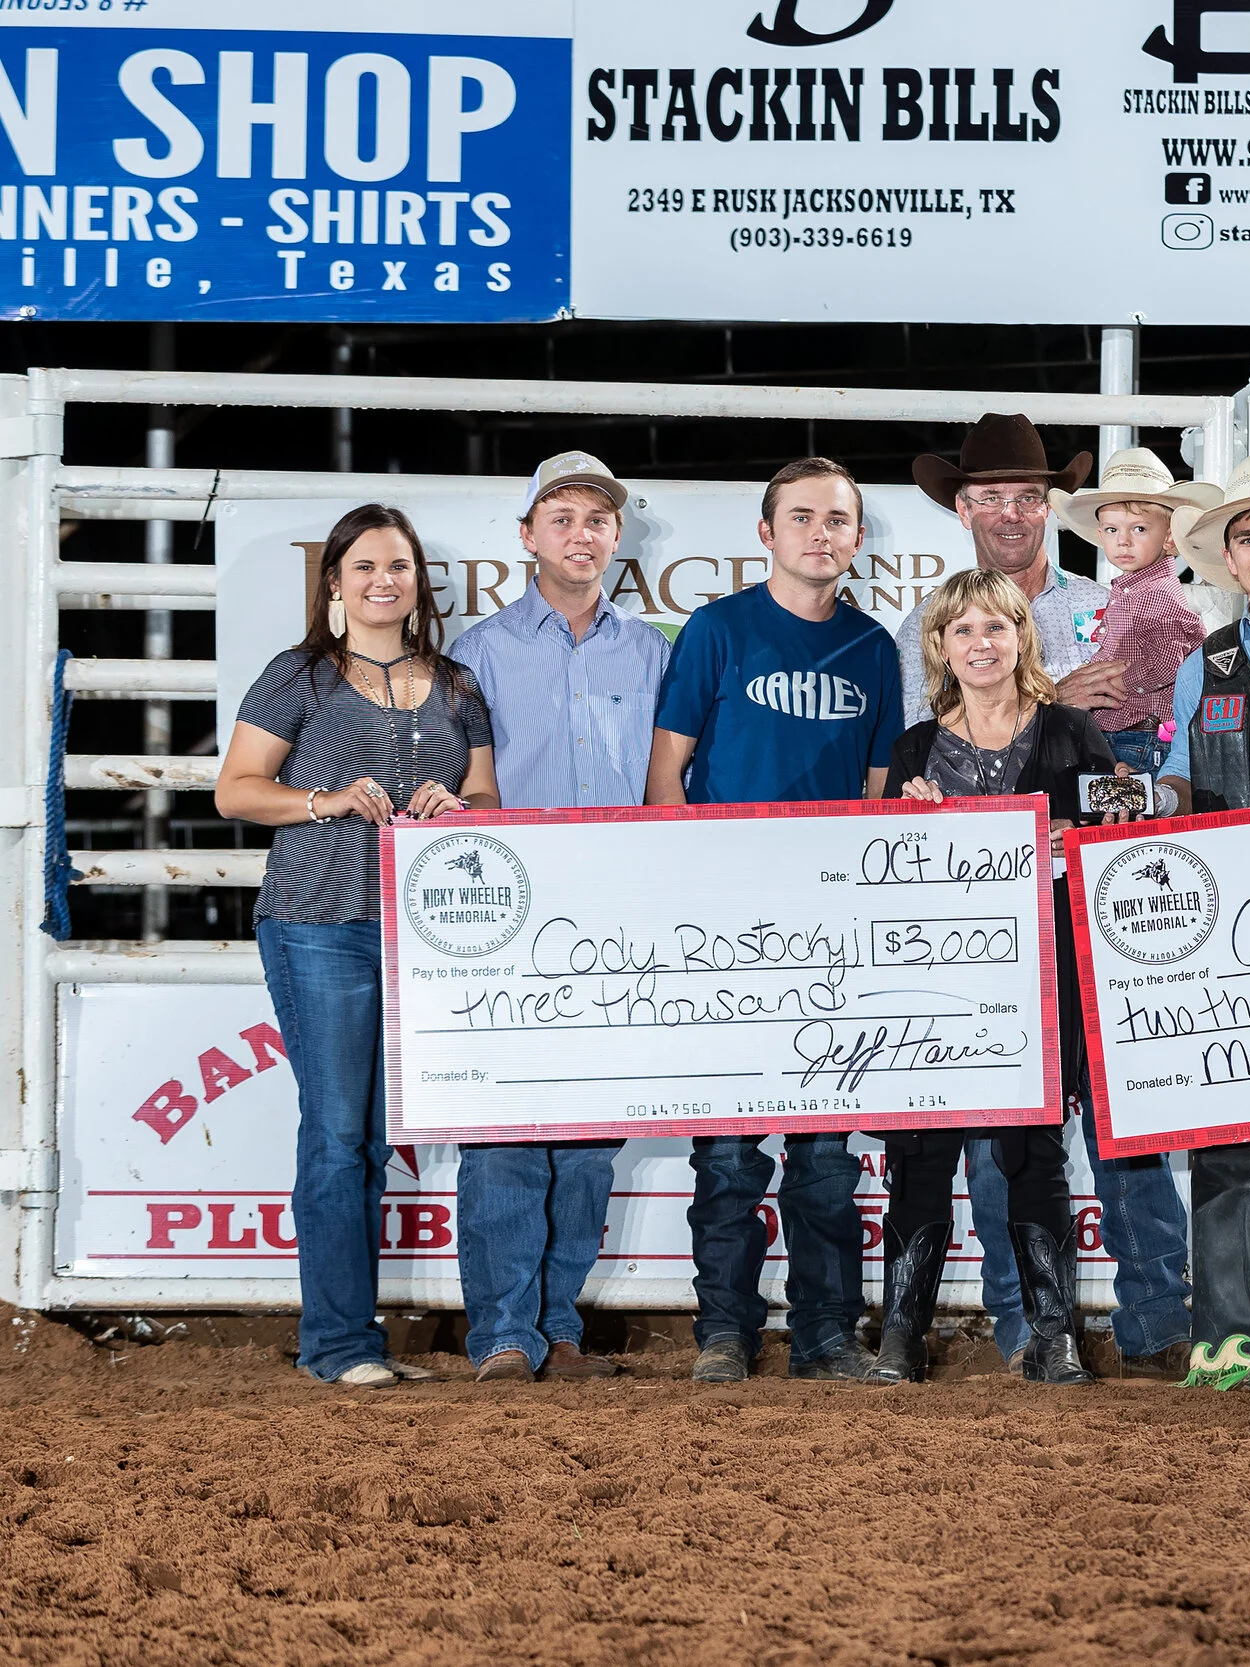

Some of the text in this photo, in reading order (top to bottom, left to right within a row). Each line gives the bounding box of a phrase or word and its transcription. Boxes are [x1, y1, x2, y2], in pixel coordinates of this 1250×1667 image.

[113, 48, 516, 182] SHOP
[586, 67, 1062, 142] STACKIN BILLS
[1123, 89, 1199, 115] STACKIN
[266, 188, 511, 246] SHIRTS
[627, 188, 1016, 220] 2349 E RUSK JACKSONVILLE, TX
[729, 227, 914, 252] (903)-339-6619
[277, 250, 511, 292] Texas
[746, 671, 867, 720] OAKLEY
[900, 832, 928, 842] 1234
[473, 838, 512, 864] PROVIDING
[1158, 846, 1198, 869] PROVIDING
[820, 871, 850, 883] Date:
[422, 886, 512, 911] NICKY WHEELER
[1112, 891, 1202, 924] NICKY WHEELER
[439, 910, 497, 924] MEMORIAL
[1099, 868, 1214, 960] SCHOLARSHIPS FOR THE YOUTH AGRICULTURE OF CHEROKEE
[1131, 915, 1188, 934] MEMORIAL
[532, 917, 670, 1001] Cody
[885, 924, 1013, 970] $3,000
[412, 965, 515, 978] Pay to the order of
[1109, 968, 1210, 991] Pay to the order of
[592, 980, 846, 1027] thousand
[979, 1002, 1018, 1014] Dollars
[1117, 996, 1194, 1043] two
[421, 1069, 490, 1082] Donated By:
[1126, 1073, 1194, 1091] Donated By:
[908, 1096, 947, 1108] 1234
